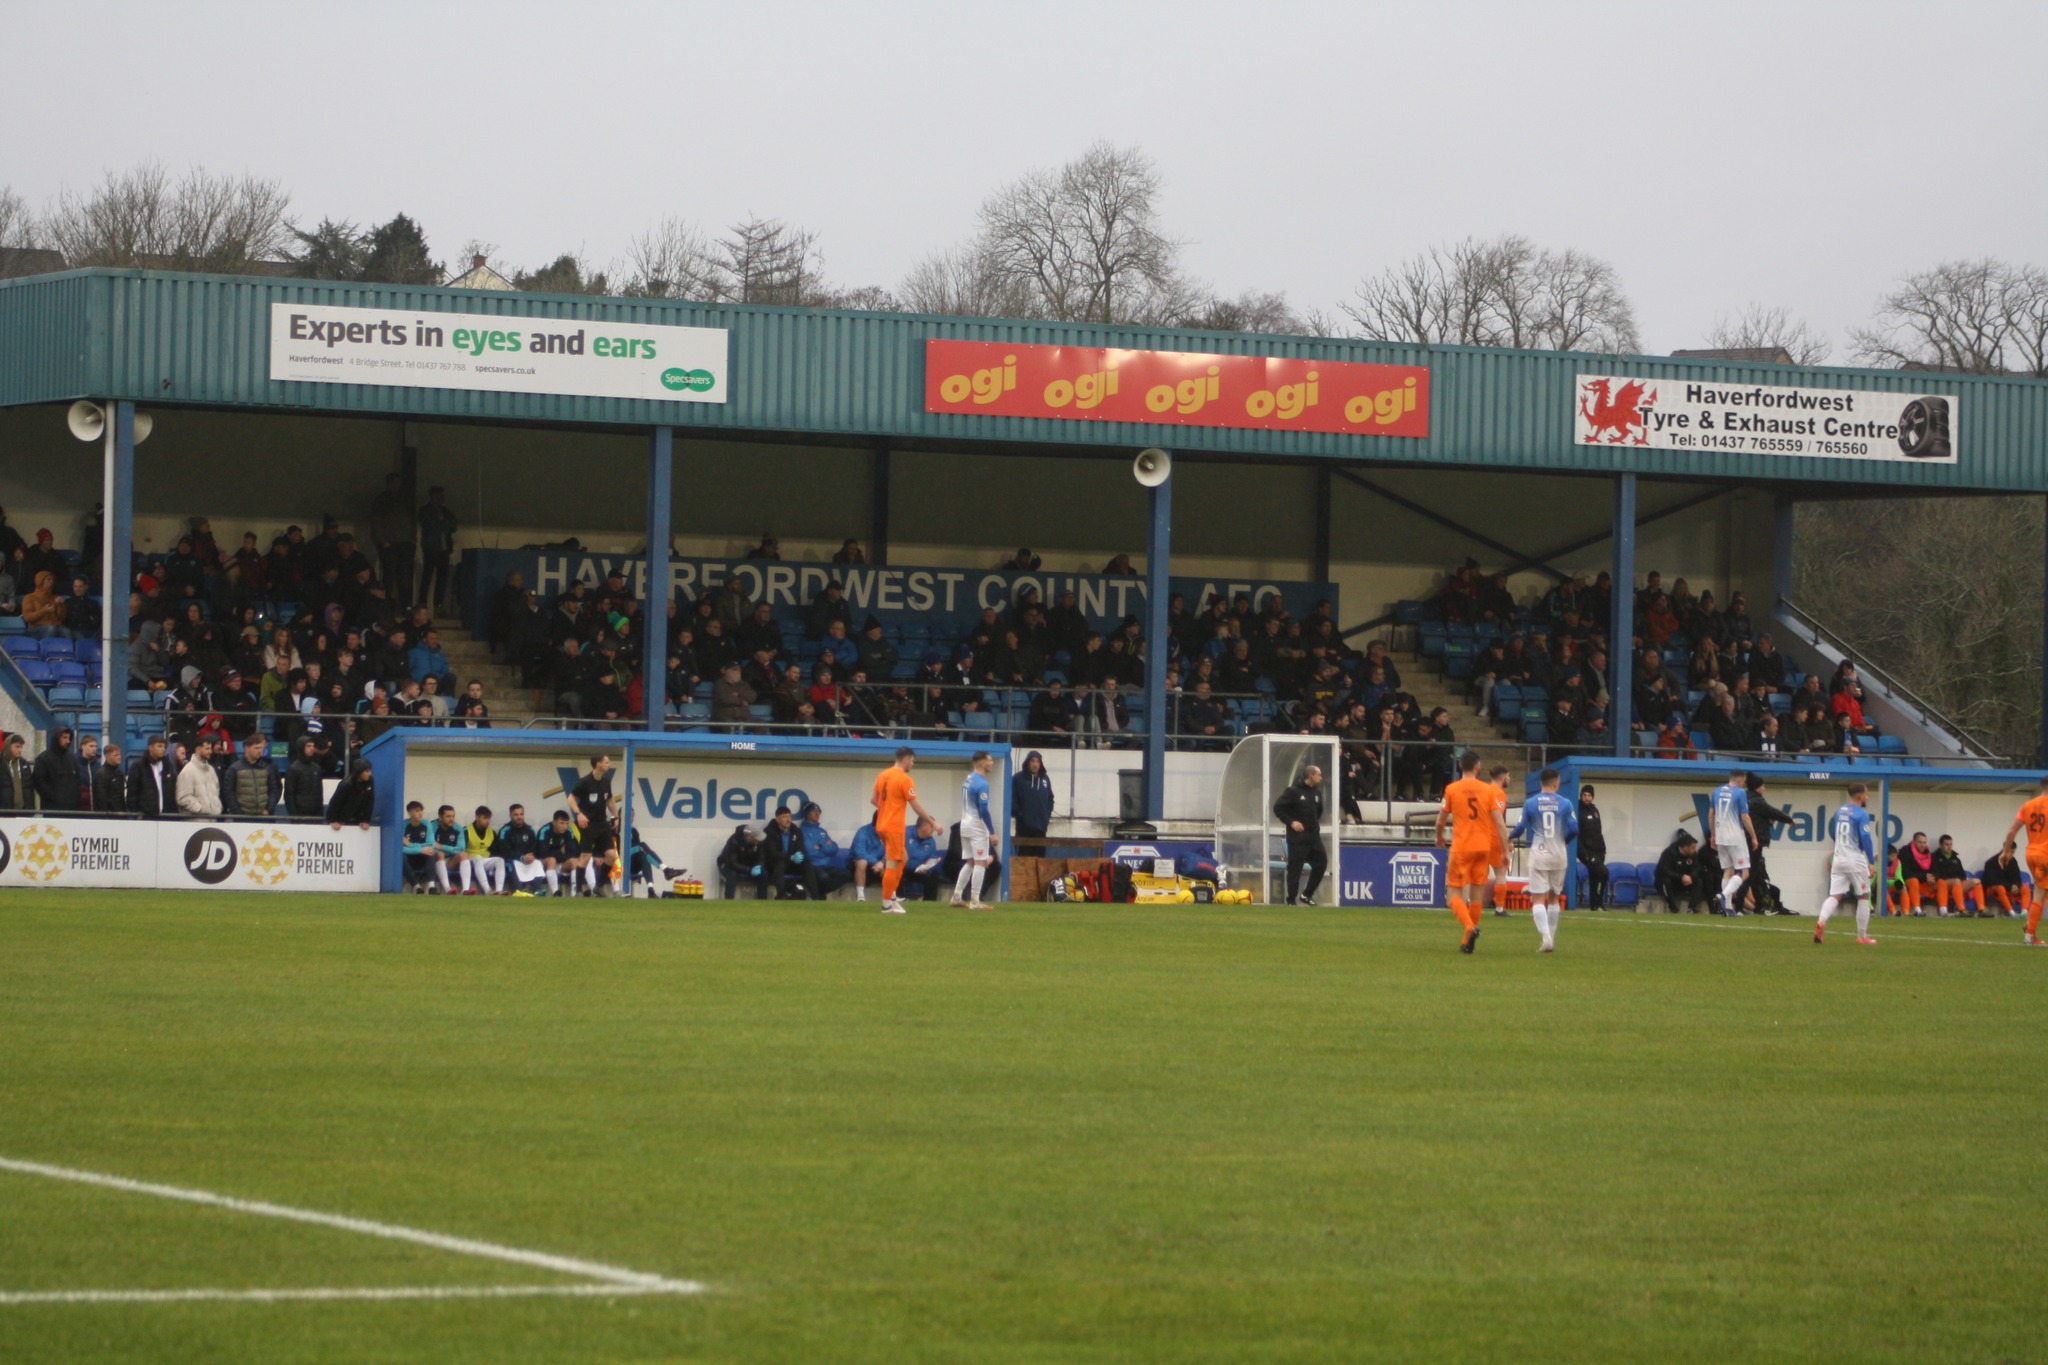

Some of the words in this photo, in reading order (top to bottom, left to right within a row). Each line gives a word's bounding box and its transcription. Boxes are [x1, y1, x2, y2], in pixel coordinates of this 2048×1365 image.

[290, 314, 407, 348] Experts
[416, 320, 443, 347] in
[452, 327, 522, 356] eyes
[530, 329, 585, 355] and
[593, 337, 657, 359] ears
[289, 354, 343, 364] Haverfordwest
[356, 358, 378, 368] Bridge
[405, 360, 415, 368] Tel
[417, 361, 437, 370] 01437
[475, 365, 536, 375] specsavers.co.uk
[665, 373, 710, 384] Specsavers
[940, 354, 1017, 404] ogi
[1043, 359, 1119, 409] ogi
[1145, 365, 1220, 414] ogi
[1245, 370, 1319, 419] ogi
[1344, 376, 1416, 425] ogi
[1686, 384, 1853, 412] Haverfordwest
[1639, 407, 1690, 431] Tyre
[1699, 410, 1714, 430] &
[1724, 412, 1816, 435] Exhaust
[1824, 417, 1898, 439] Centre
[1670, 433, 1697, 446] Tel:
[1701, 434, 1745, 449] 01437
[1751, 437, 1803, 452] 765559
[1816, 441, 1868, 456] 765560
[978, 574, 1148, 619] COUNT
[731, 741, 756, 751] HOME
[1809, 772, 1830, 781] AWAY
[638, 777, 811, 821] Valero
[1467, 797, 1478, 820] 5
[1718, 797, 1731, 819] 17
[1542, 811, 1556, 838] 9
[1835, 821, 1850, 847] 18
[2030, 812, 2046, 833] 29
[71, 837, 119, 853] CYMRU
[190, 840, 231, 870] JD
[297, 842, 343, 858] CYMRU
[71, 854, 130, 870] PREMIER
[297, 859, 354, 875] PREMIER
[1401, 865, 1427, 875] WEST
[1344, 881, 1374, 900] UK
[1397, 875, 1429, 885] WALES
